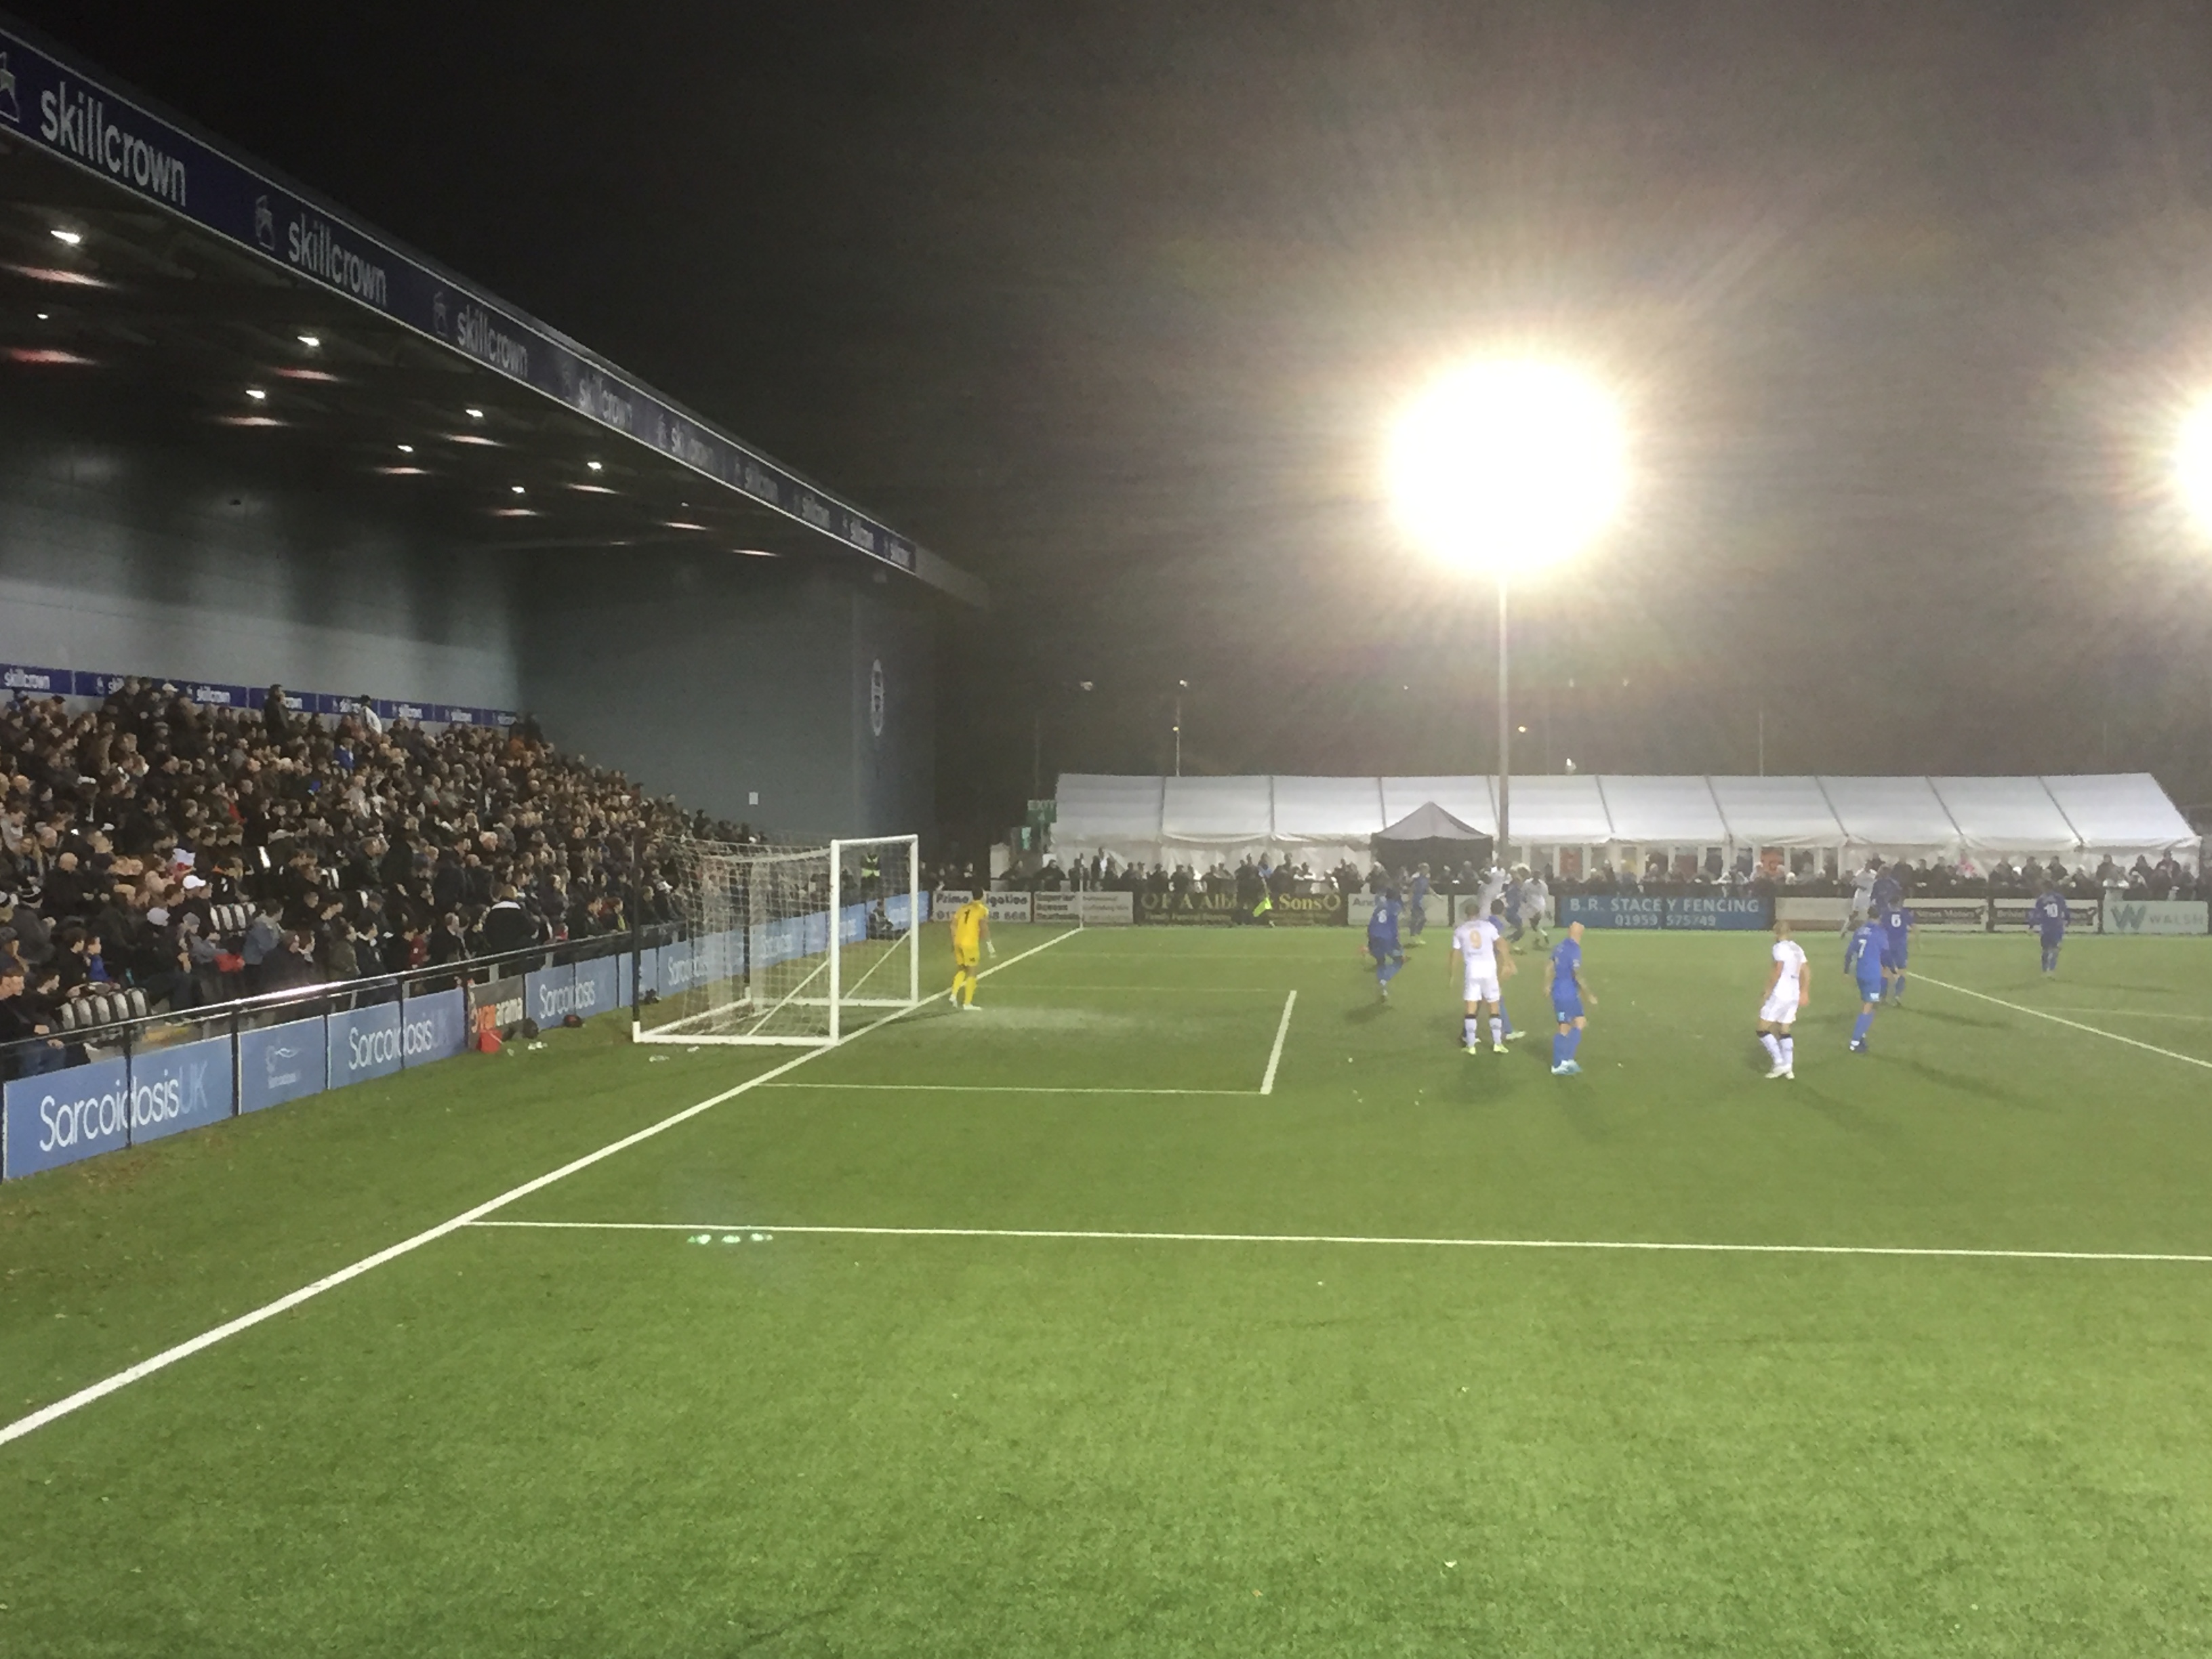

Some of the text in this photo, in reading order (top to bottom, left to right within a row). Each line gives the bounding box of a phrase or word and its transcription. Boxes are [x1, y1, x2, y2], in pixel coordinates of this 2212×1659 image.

[40, 81, 186, 207] skillcrown
[288, 213, 388, 308] skillcrown
[457, 304, 528, 377] skillcrown
[1279, 893, 1322, 910] Sons
[1683, 899, 1759, 913] FENCING
[2044, 902, 2058, 918] 10
[963, 909, 971, 924] 1
[2150, 914, 2204, 924] WALSH
[1469, 929, 1482, 949] 9
[1858, 939, 1868, 958] 7
